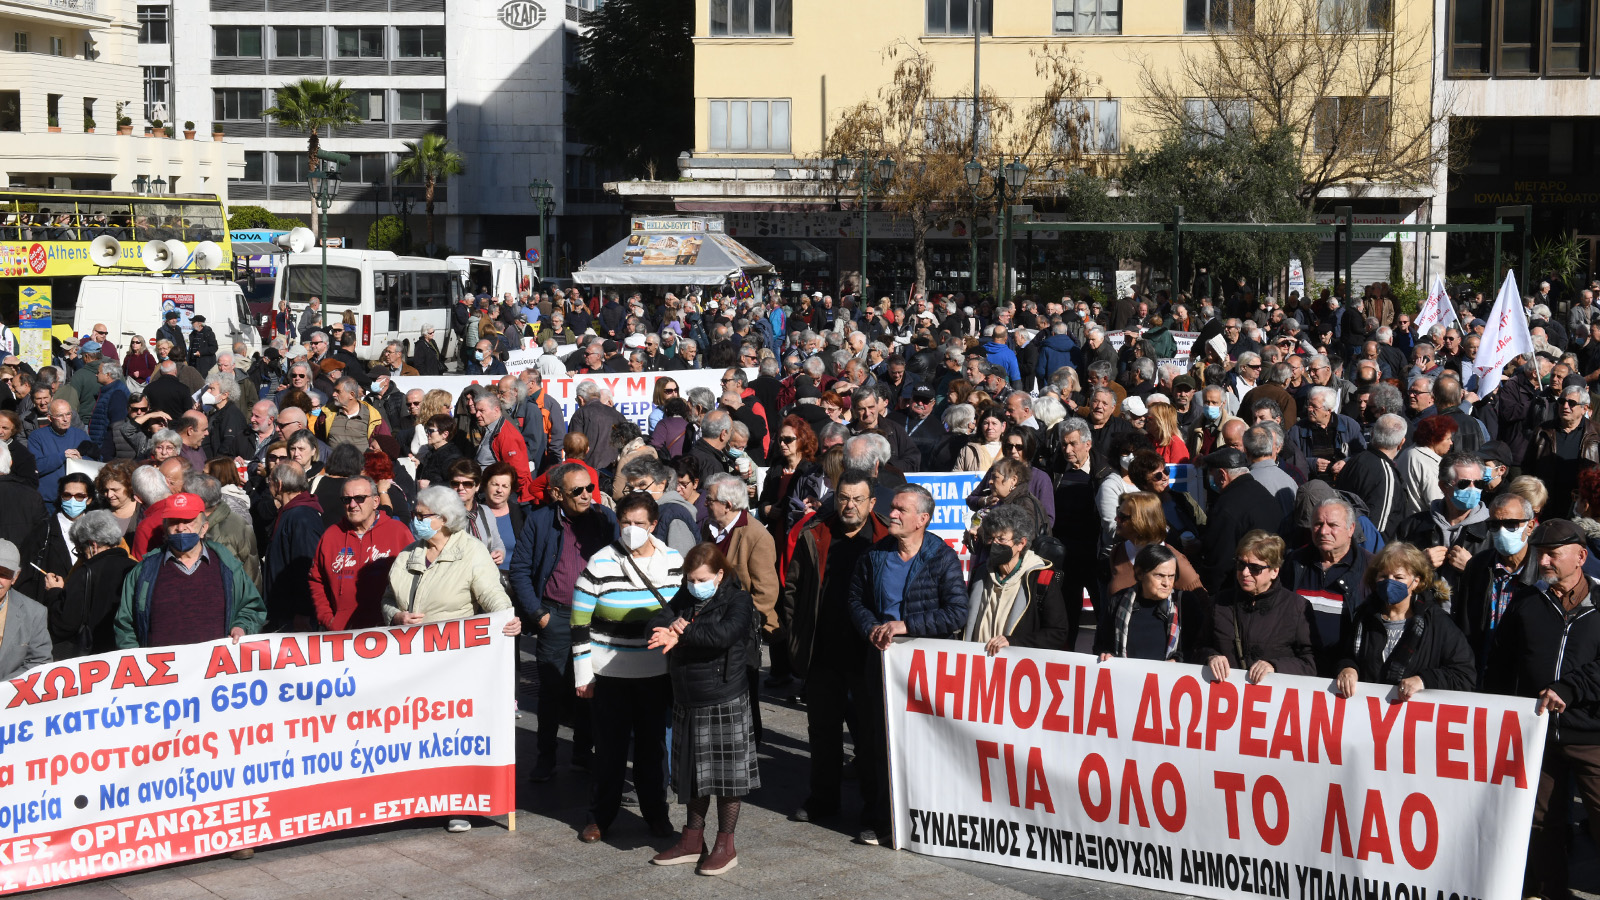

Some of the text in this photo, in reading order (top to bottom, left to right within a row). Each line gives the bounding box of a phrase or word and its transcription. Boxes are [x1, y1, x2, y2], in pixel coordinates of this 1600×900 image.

[506, 3, 537, 26] ΗΣΑΠ
[646, 221, 691, 229] HELLAS-EGYPT
[1474, 193, 1521, 203] ΙΟΥΛΙΑΣ
[1541, 193, 1600, 203] ΣΤΑΘΑΤΟ
[1514, 181, 1567, 191] ΜΕΓΑΡΟ
[5, 617, 491, 709] ΧΩΡΑΣ ΑΠΑΙΤΟΥΜΕ
[45, 697, 200, 737] κατώτερη
[211, 679, 268, 712] 650
[278, 668, 356, 705] ευρώ
[25, 729, 219, 785] προστασίας
[228, 722, 274, 755] για
[284, 714, 337, 742] την
[346, 696, 473, 733] ακρίβεια
[906, 649, 1528, 789] ΔΗΜΟΣΙΑ ΔΩΡΕΑΝ ΥΓΕΙΑ
[100, 783, 130, 811] Να
[137, 767, 236, 802] ανοίξουν
[242, 750, 295, 785] αυτά
[302, 749, 343, 775] που
[350, 739, 412, 774] έχουν
[419, 728, 491, 759] κλείσει
[976, 739, 1439, 870] ΓΙΑ ΟΛΟ ΤΟ ΛΑΟ
[26, 841, 172, 887] ΔΙΚΗΓΟΡΩΝ
[194, 822, 274, 854] ΠΟΣΕΑ
[279, 807, 352, 837] ΕΤΕΑΠ
[373, 794, 491, 819] ΕΣΤΑΜΕΔΕ
[70, 797, 272, 851] ΟΡΓΑΝΩΣΕΙΣ
[909, 808, 1020, 857] ΣΥΝΔΕΣΜΟΣ
[1026, 823, 1174, 881] ΣΥΝΤΑΞΙΟΥΧΩΝ
[1180, 848, 1290, 899] ΔΗΜΟΣΙΩΝ
